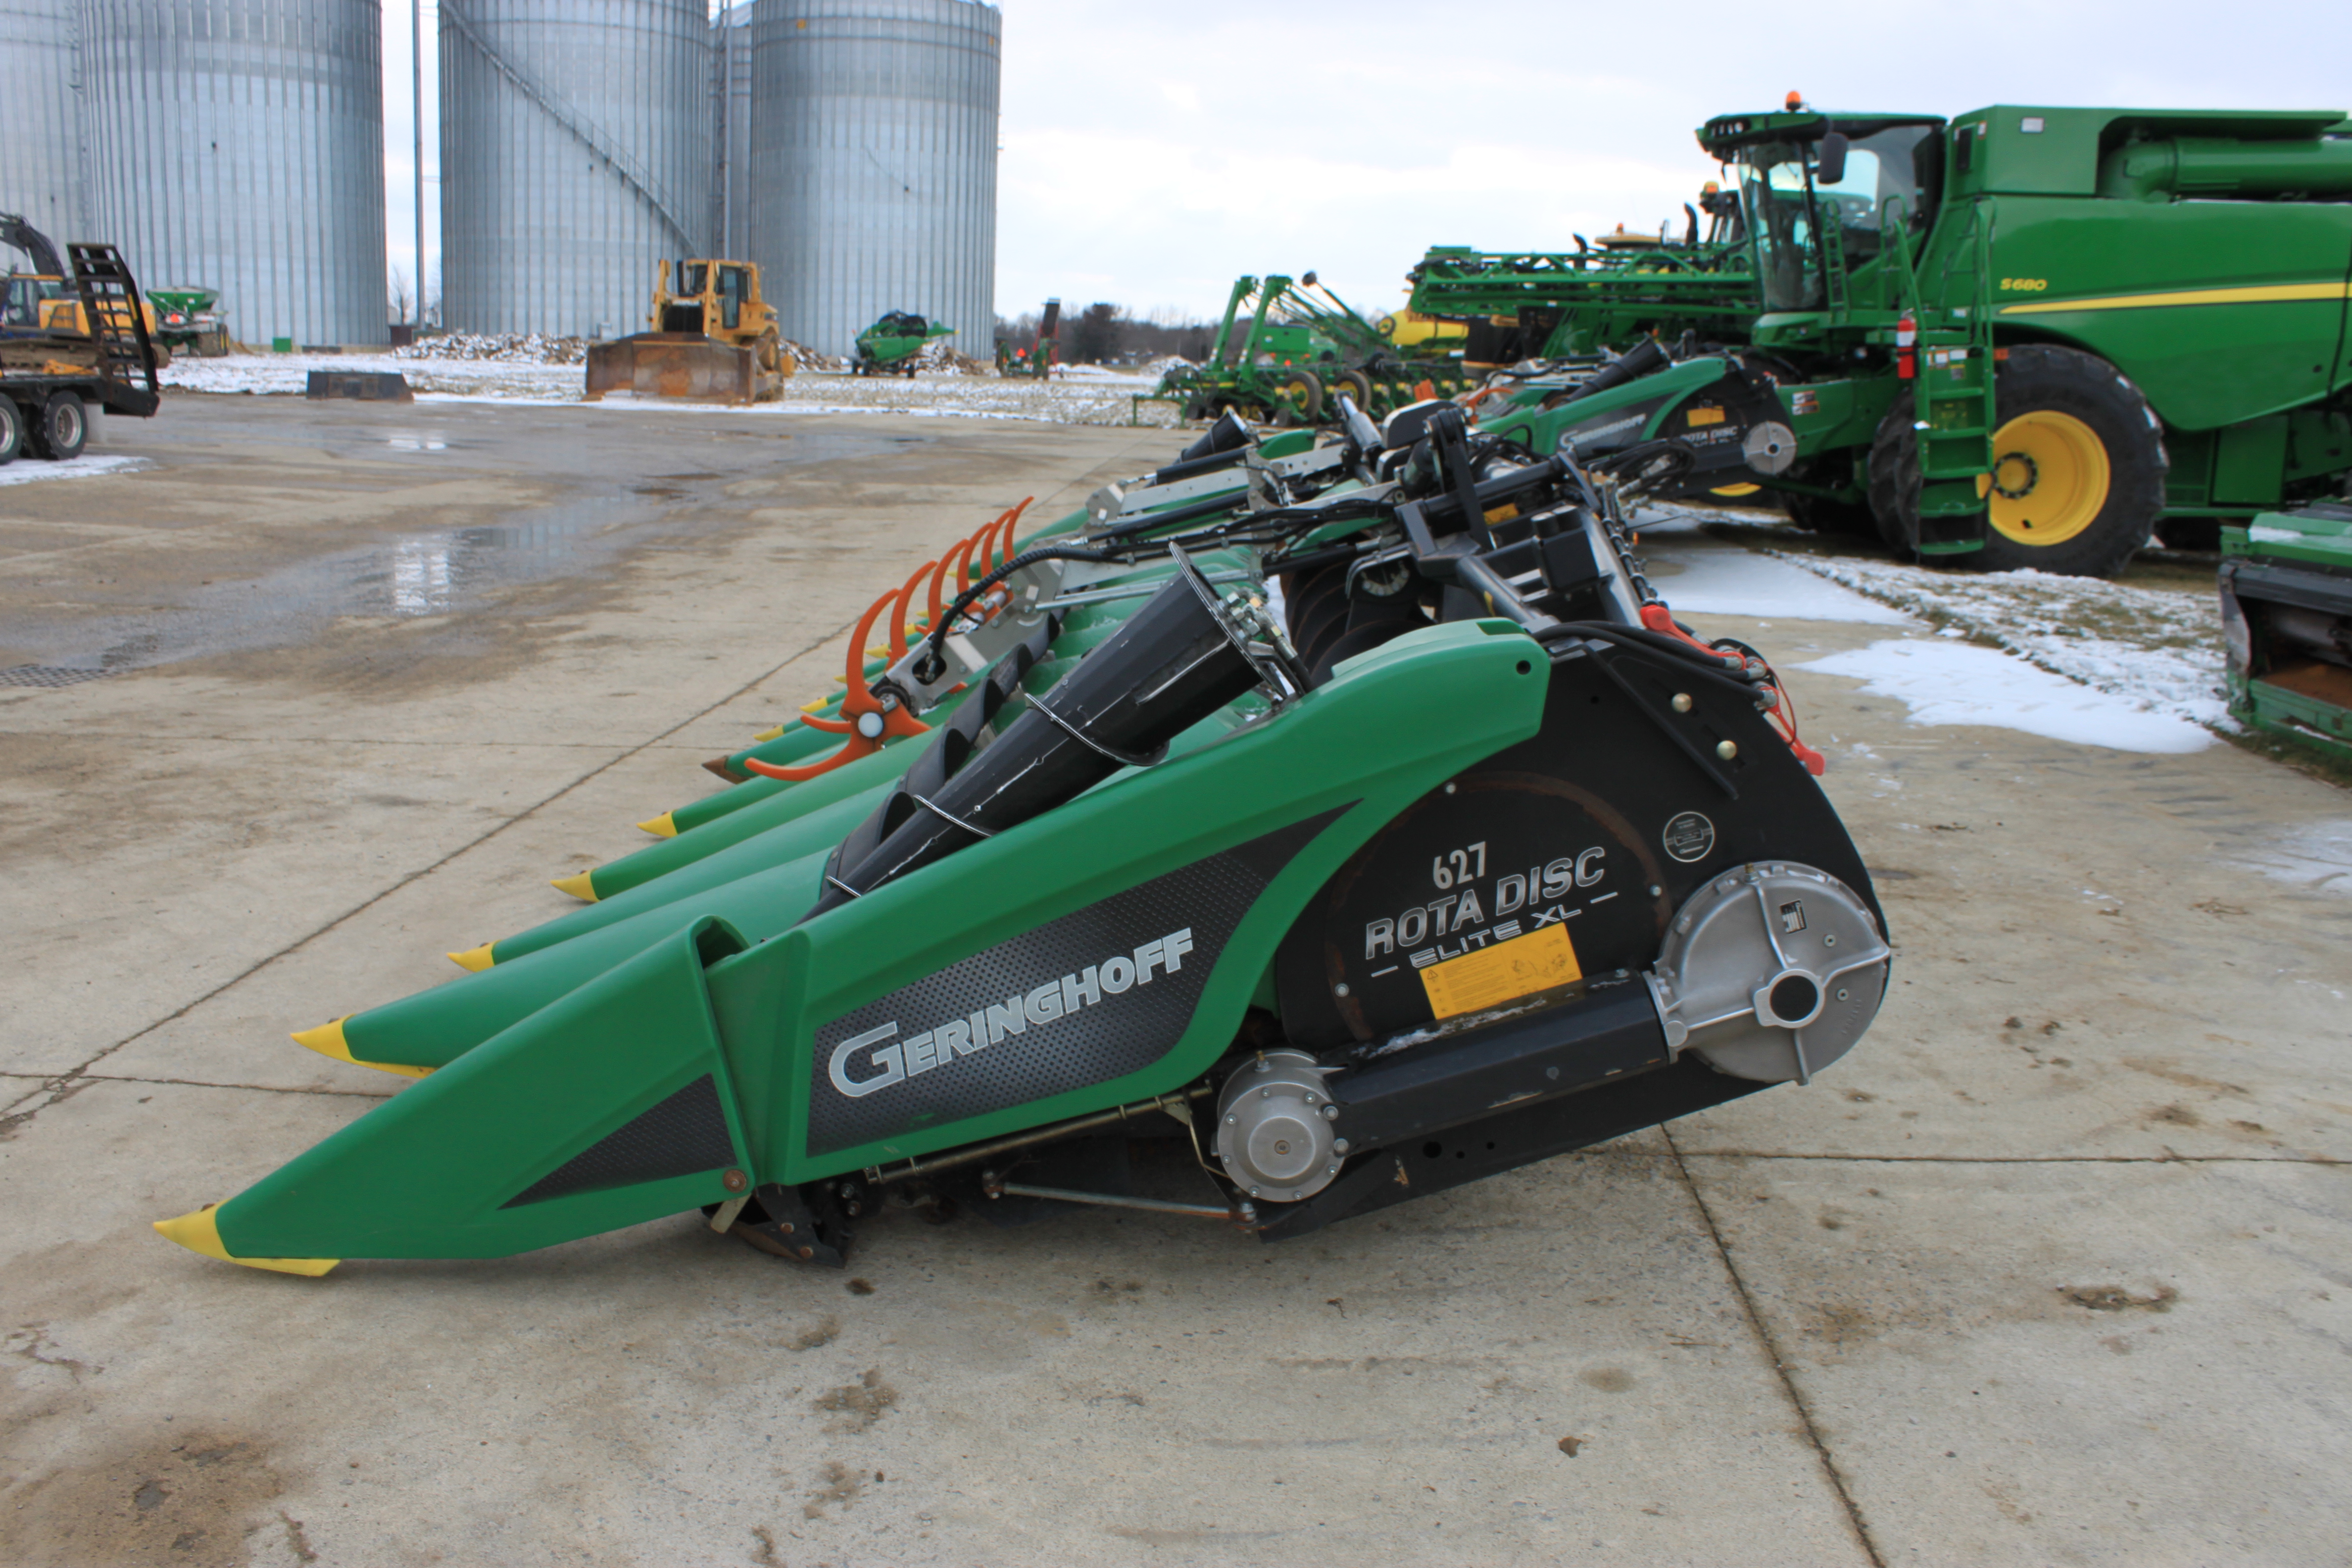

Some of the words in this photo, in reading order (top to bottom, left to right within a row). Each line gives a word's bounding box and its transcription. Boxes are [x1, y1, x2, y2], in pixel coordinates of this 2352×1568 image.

[2000, 278, 2047, 291] S680
[1433, 841, 1486, 889] 627
[1366, 889, 1484, 960] ROTA
[1496, 846, 1605, 916] DISC
[1410, 919, 1522, 968] ELITE
[1531, 904, 1582, 929] XL
[829, 927, 1193, 1097] GERINGHOFF
